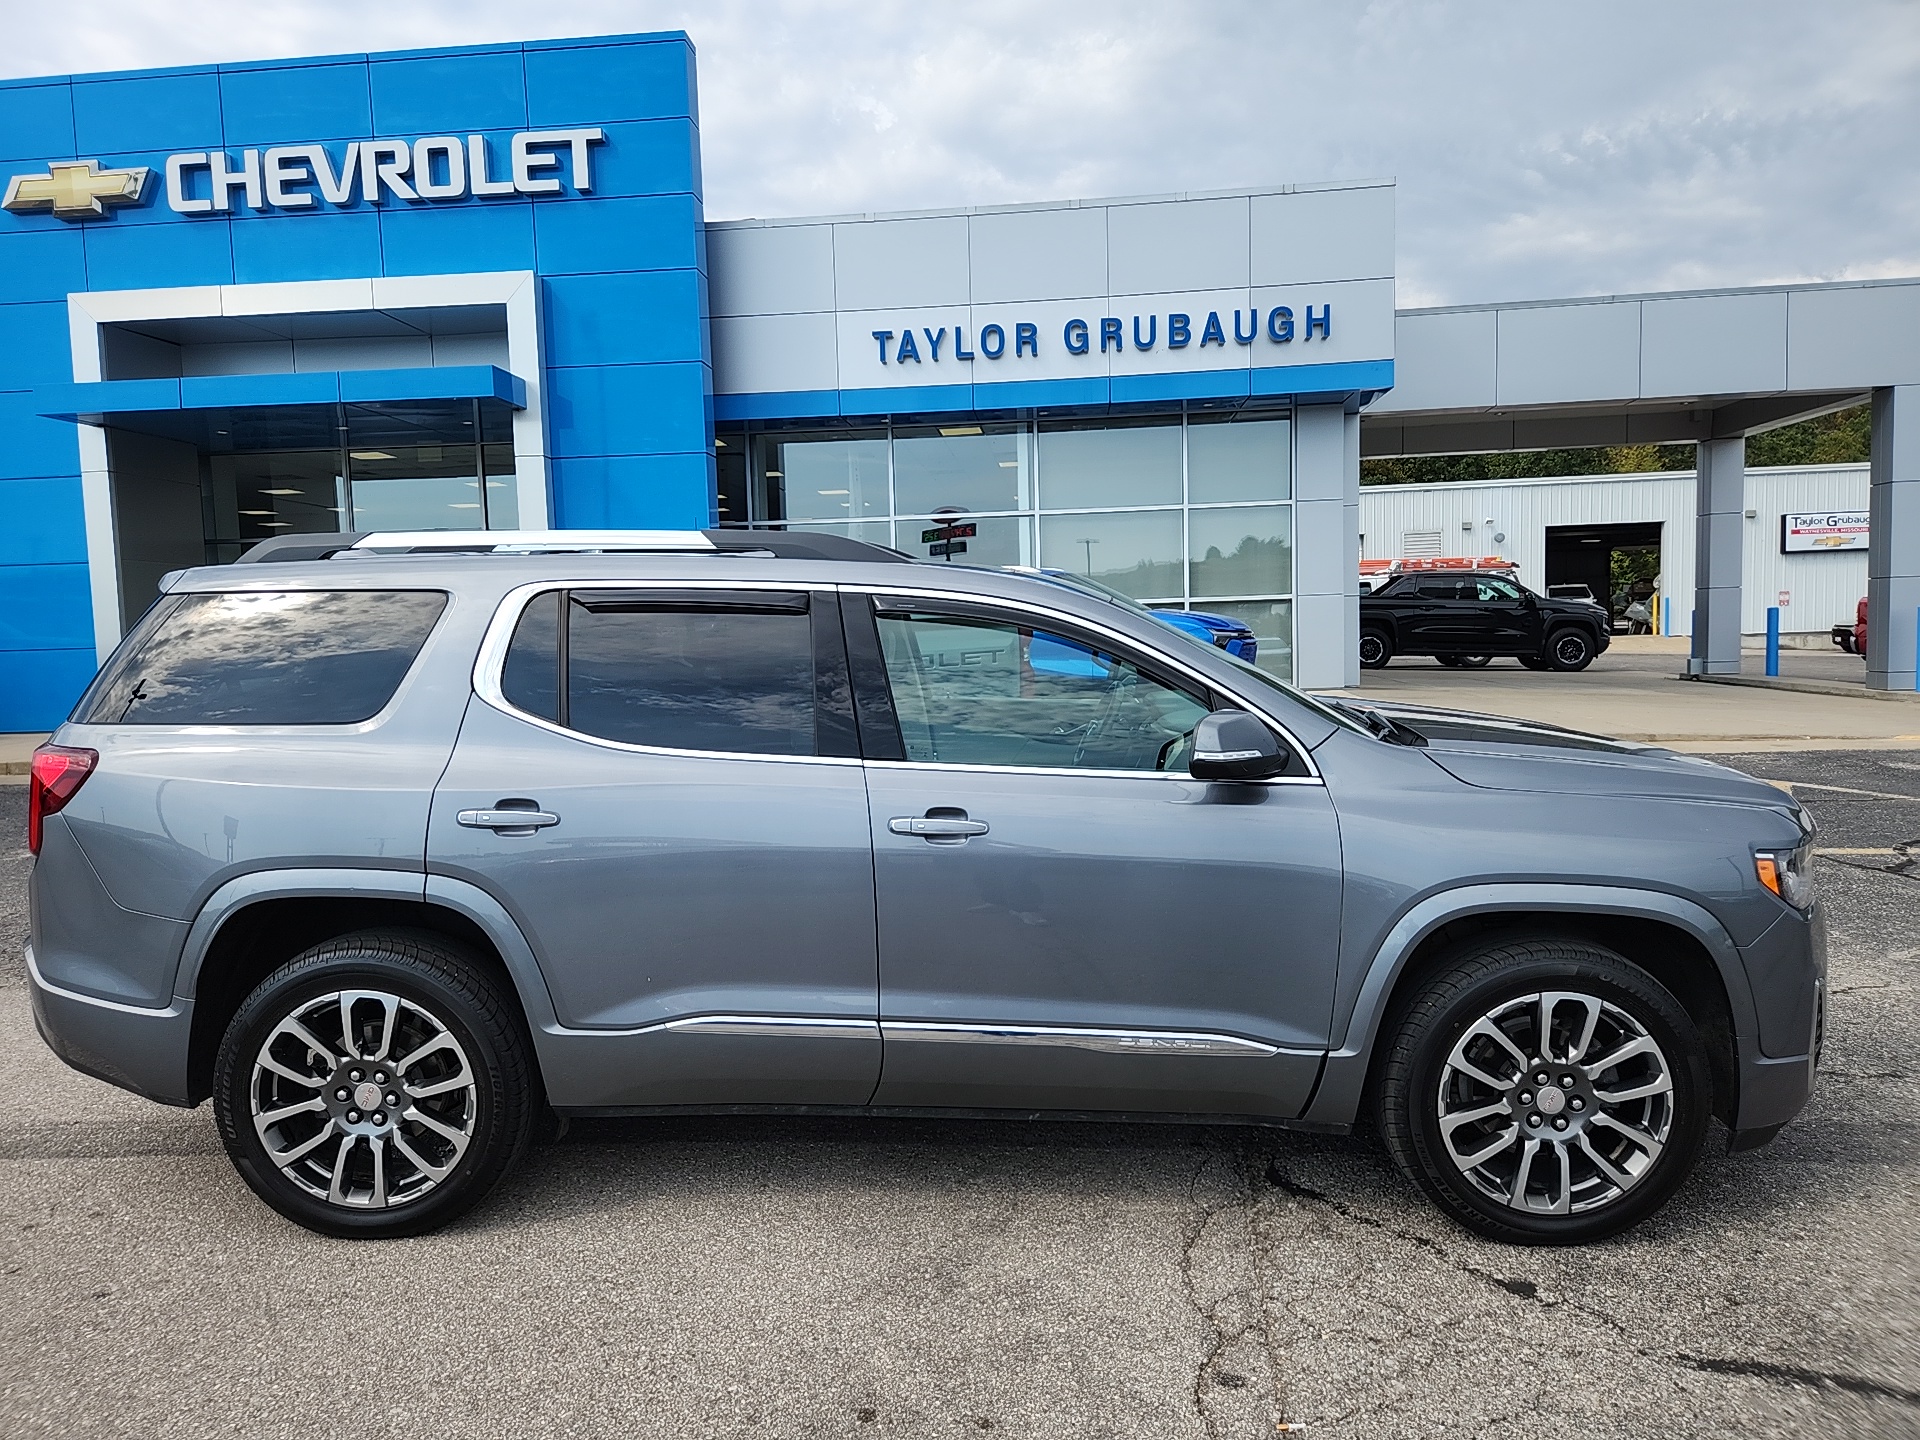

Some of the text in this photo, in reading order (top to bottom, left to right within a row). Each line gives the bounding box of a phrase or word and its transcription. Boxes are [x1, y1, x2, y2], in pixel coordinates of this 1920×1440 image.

[165, 127, 605, 214] CHEVROLET
[871, 303, 1331, 364] TAYLOR GRUBAUGH
[1791, 515, 1870, 528] Taylor Grubaug
